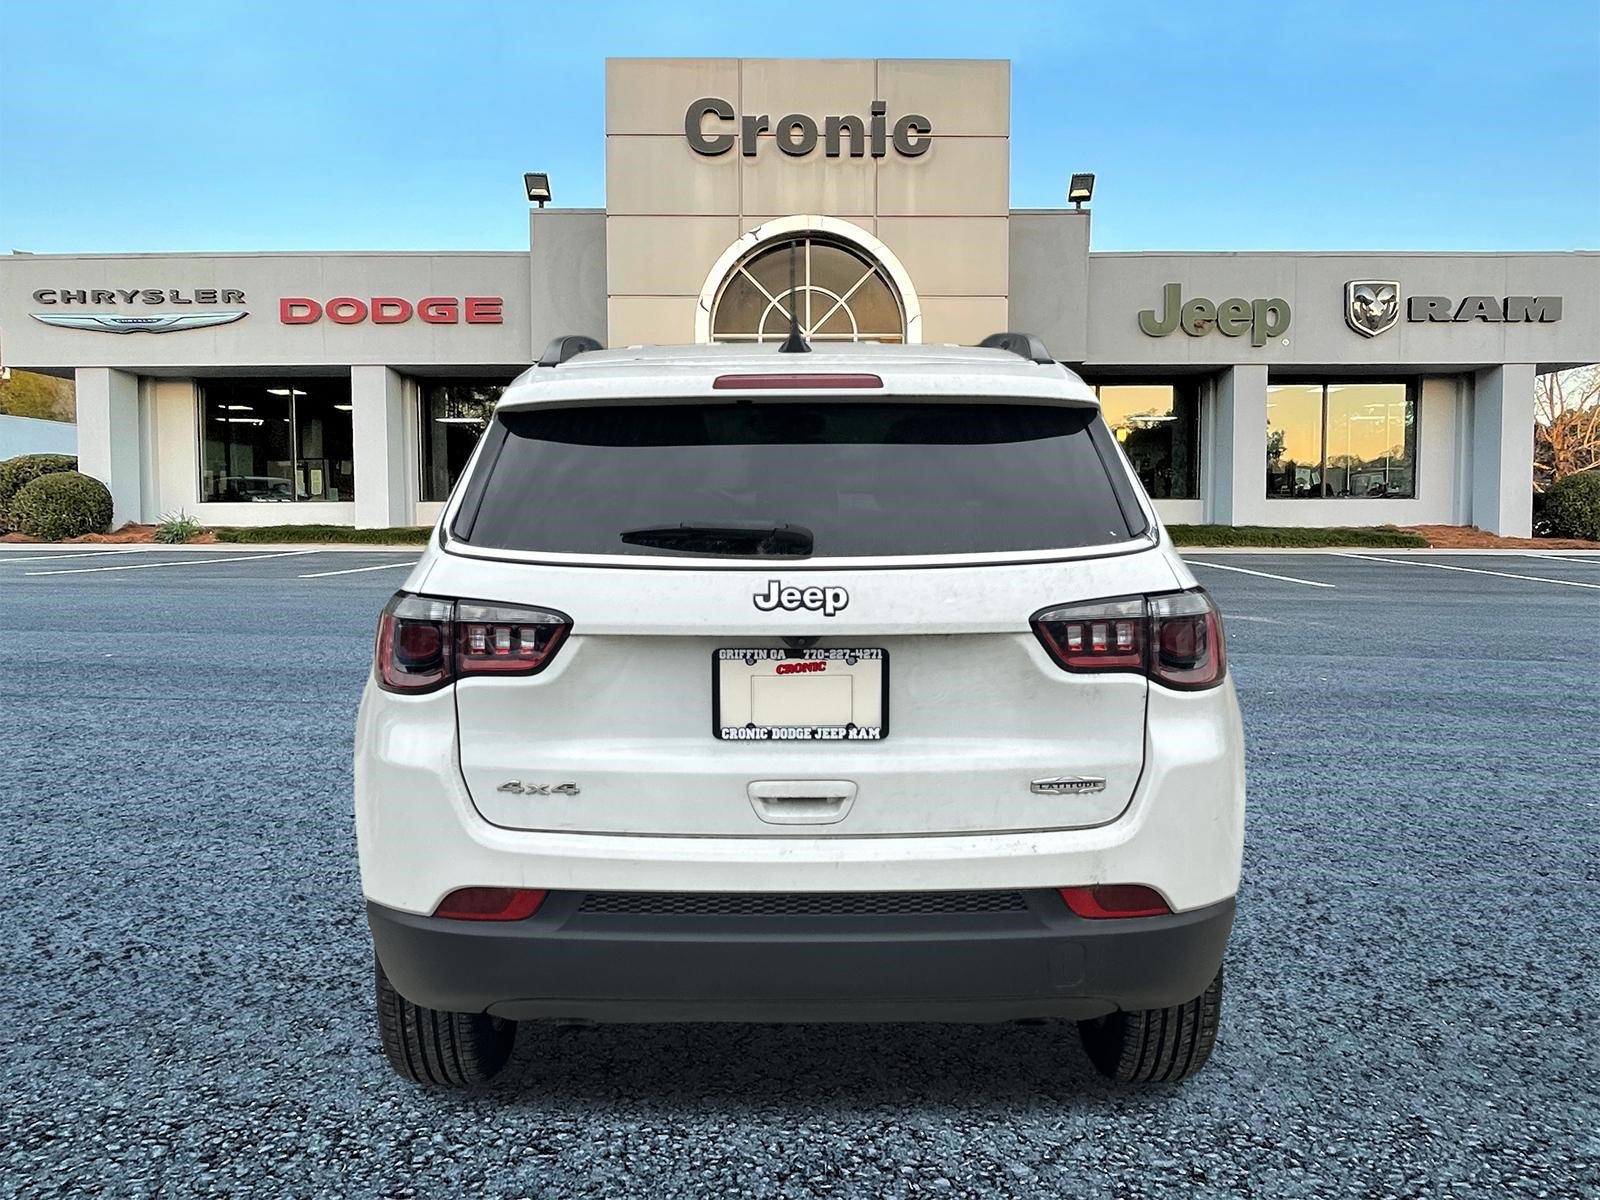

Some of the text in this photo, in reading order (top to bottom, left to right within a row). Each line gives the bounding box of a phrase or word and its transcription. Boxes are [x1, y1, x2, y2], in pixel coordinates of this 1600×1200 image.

[685, 98, 932, 157] Cronic
[32, 289, 246, 304] CHRYSLER
[280, 297, 504, 325] DODGE
[1138, 283, 1291, 347] Jeep
[1407, 296, 1563, 323] RAM
[753, 580, 849, 616] Jeep
[719, 649, 786, 660] GRIFFIN GA
[803, 649, 882, 660] 770-227-4271
[776, 661, 827, 674] CRONIC
[721, 728, 880, 740] CRONIC DODGE JEEP RAM
